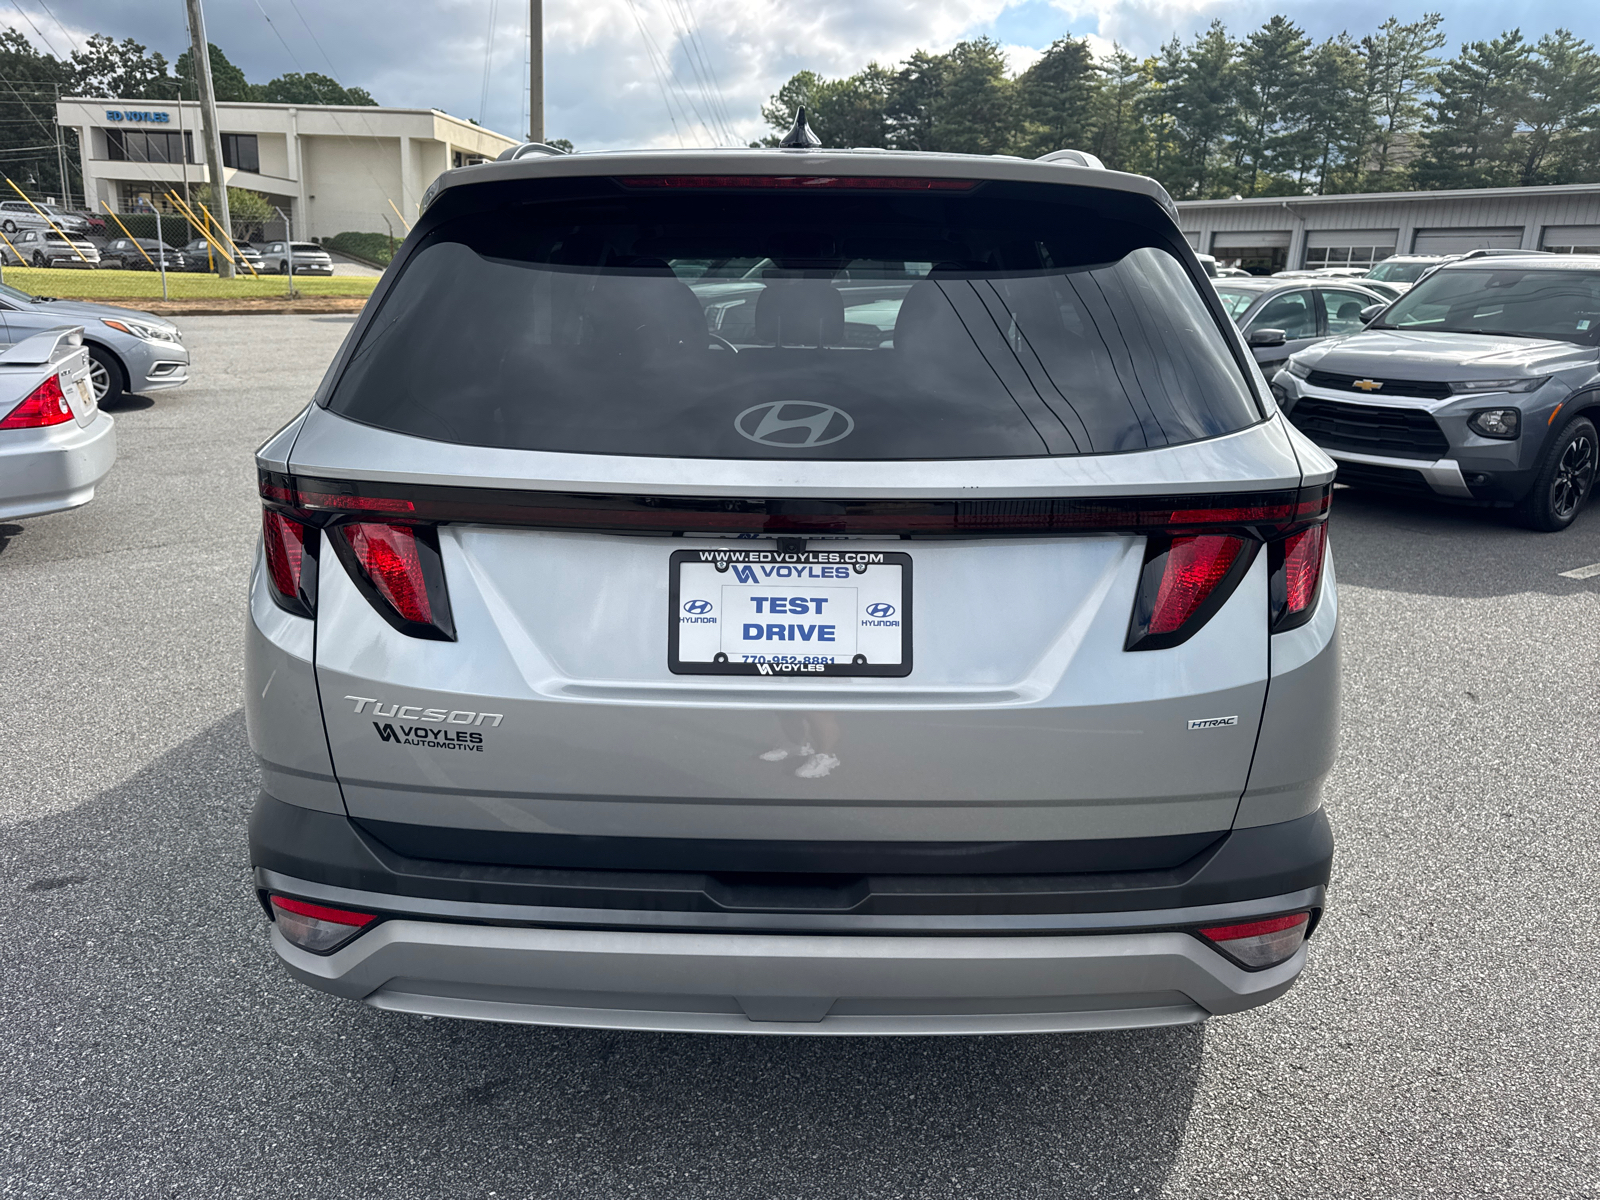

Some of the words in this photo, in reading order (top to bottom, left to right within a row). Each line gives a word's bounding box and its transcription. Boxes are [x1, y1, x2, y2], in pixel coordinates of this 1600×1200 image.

[106, 110, 124, 121] ED
[124, 111, 170, 123] VOYLES
[760, 565, 850, 579] VOYLES
[750, 596, 829, 615] TEST
[679, 616, 717, 624] HYUNDAI
[861, 619, 900, 627] HYUNDAI
[742, 623, 836, 642] DRIVE
[742, 655, 835, 665] 770-952-8881
[773, 663, 825, 672] VOYLES
[1191, 717, 1235, 728] HTRAC
[399, 725, 483, 744] VOYLES
[403, 738, 484, 752] AUTOMOTIVE
